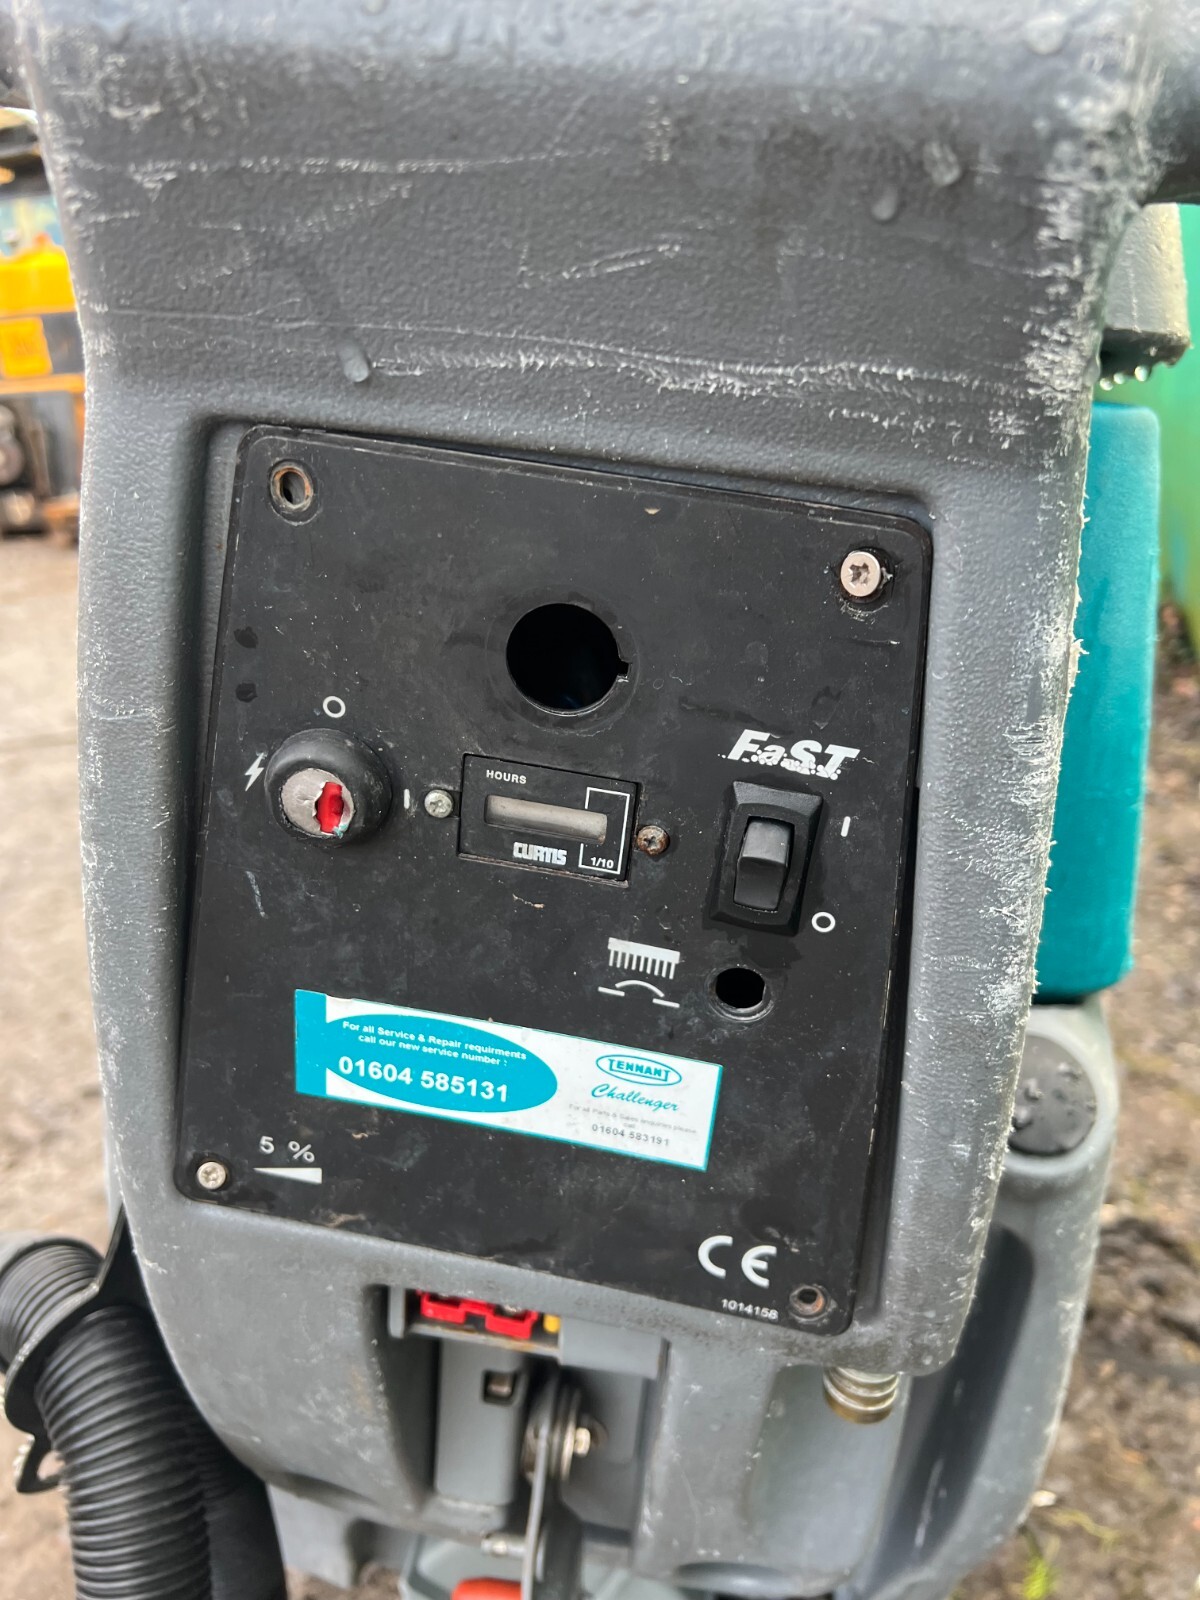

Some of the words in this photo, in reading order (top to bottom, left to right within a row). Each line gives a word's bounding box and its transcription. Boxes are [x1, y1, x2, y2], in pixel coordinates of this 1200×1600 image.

[485, 769, 528, 785] HOURS
[512, 841, 568, 866] CURTIS
[590, 856, 615, 870] 1/10
[342, 1020, 360, 1031] For
[362, 1025, 375, 1034] all
[377, 1026, 416, 1041] Service
[417, 1033, 426, 1043] &
[428, 1035, 462, 1049] Repair
[464, 1042, 527, 1061] requirments
[358, 1034, 377, 1044] call
[378, 1038, 397, 1048] our
[398, 1041, 420, 1052] new
[422, 1045, 460, 1059] service
[461, 1052, 501, 1066] number
[338, 1056, 413, 1085] 01604
[420, 1071, 509, 1103] 585131
[608, 1058, 671, 1082] TENNANT
[591, 1083, 680, 1112] Challenger
[591, 1123, 625, 1137] 01604
[628, 1131, 670, 1147] 583191
[259, 1135, 275, 1154] 5
[287, 1140, 315, 1163] %
[697, 1235, 777, 1289] CE
[721, 1298, 779, 1320] 1014158
